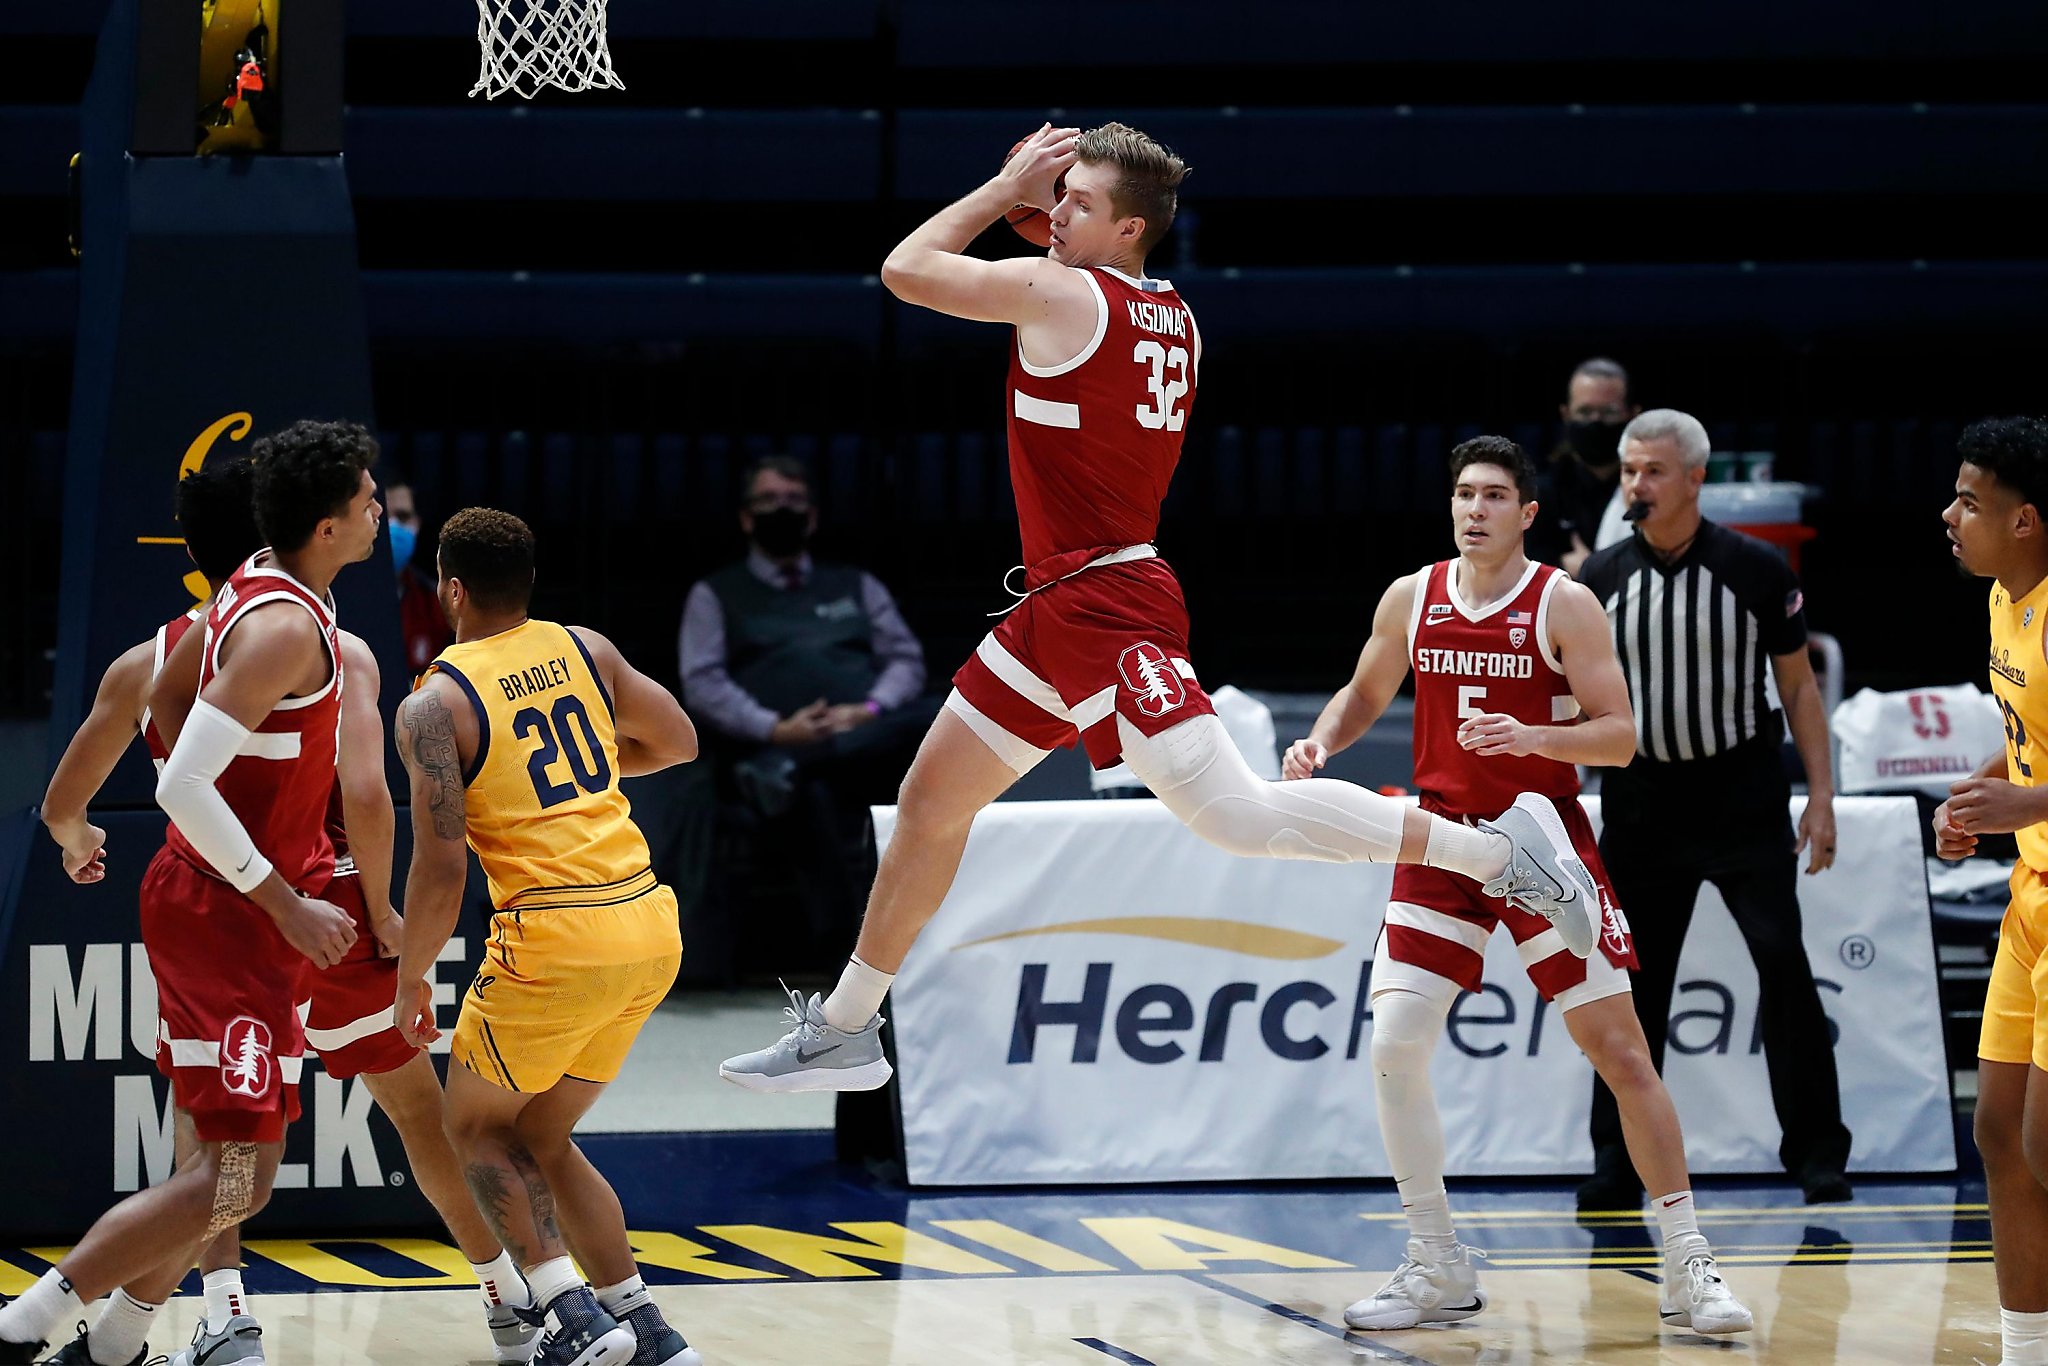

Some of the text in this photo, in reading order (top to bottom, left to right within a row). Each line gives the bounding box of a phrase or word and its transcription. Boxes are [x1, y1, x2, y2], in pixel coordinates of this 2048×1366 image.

[1125, 299, 1187, 339] KISUNAS
[1133, 340, 1189, 431] 32
[498, 657, 572, 701] BRADLEY
[1417, 648, 1533, 679] STANFORD
[512, 694, 612, 810] 20
